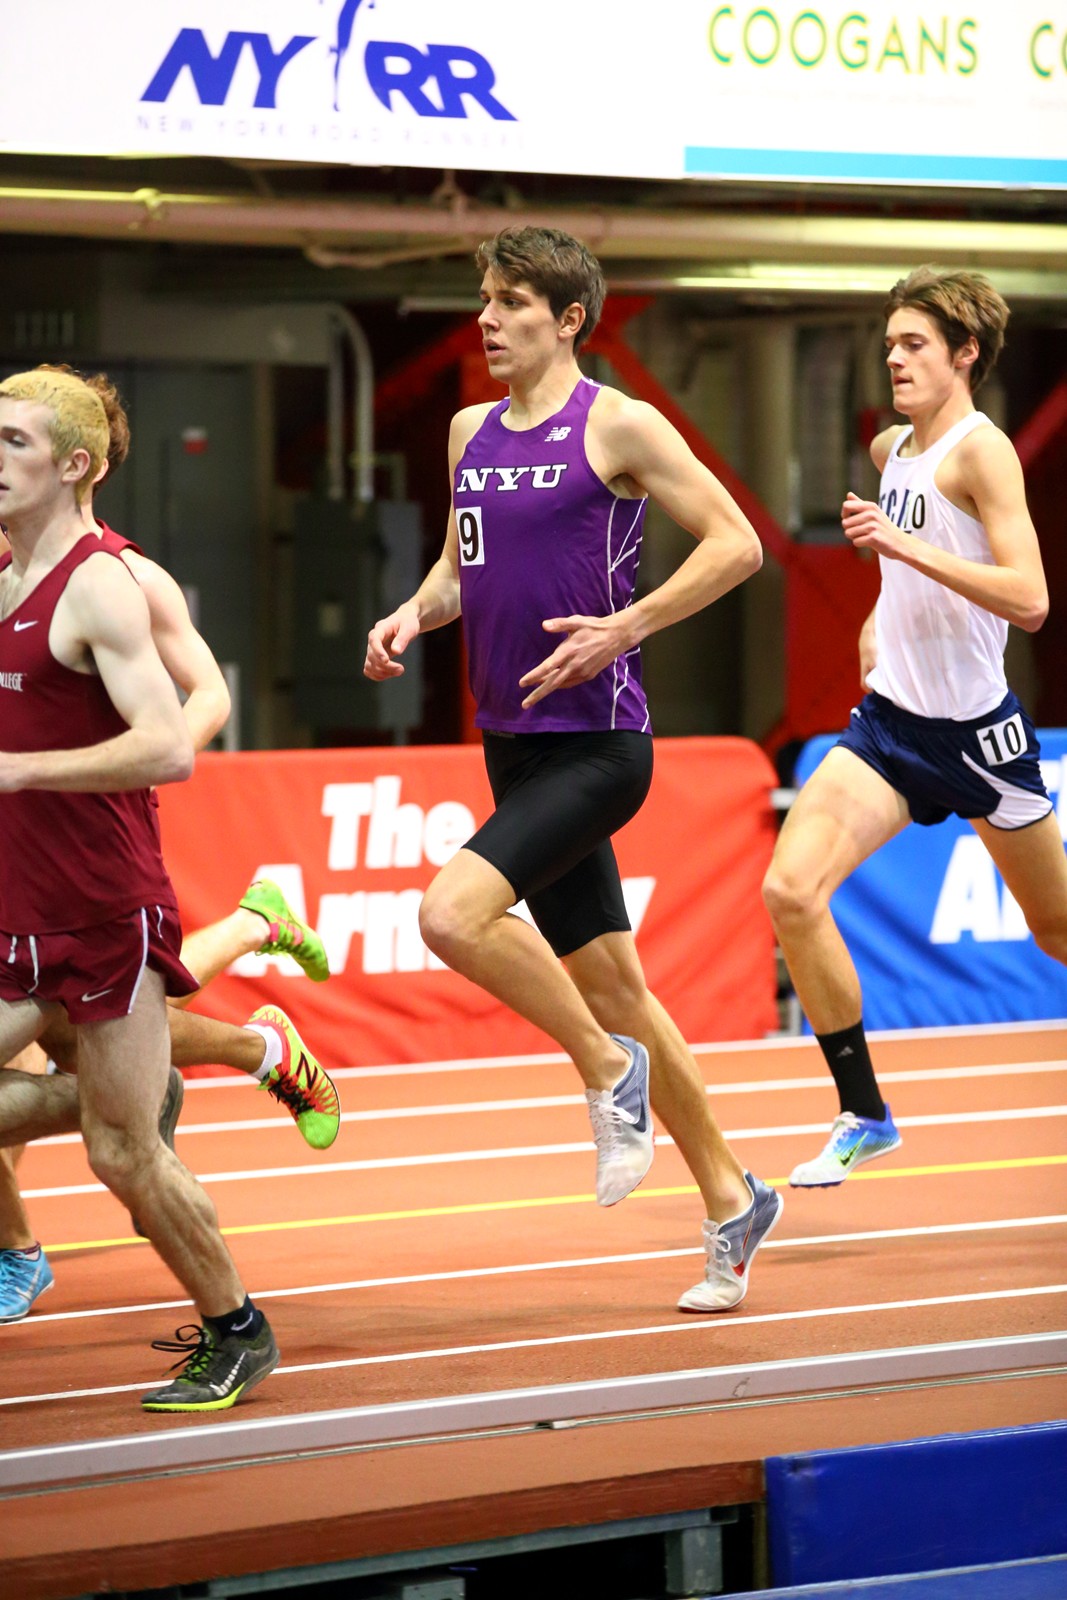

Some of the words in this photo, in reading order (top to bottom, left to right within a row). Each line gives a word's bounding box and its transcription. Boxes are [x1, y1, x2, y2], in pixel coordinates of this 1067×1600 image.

[708, 4, 978, 76] COOGANS
[1029, 21, 1067, 80] C
[136, 114, 195, 133] NEW
[456, 463, 568, 493] NYU
[459, 511, 479, 562] 9
[983, 720, 1022, 763] 10
[321, 775, 475, 871] The
